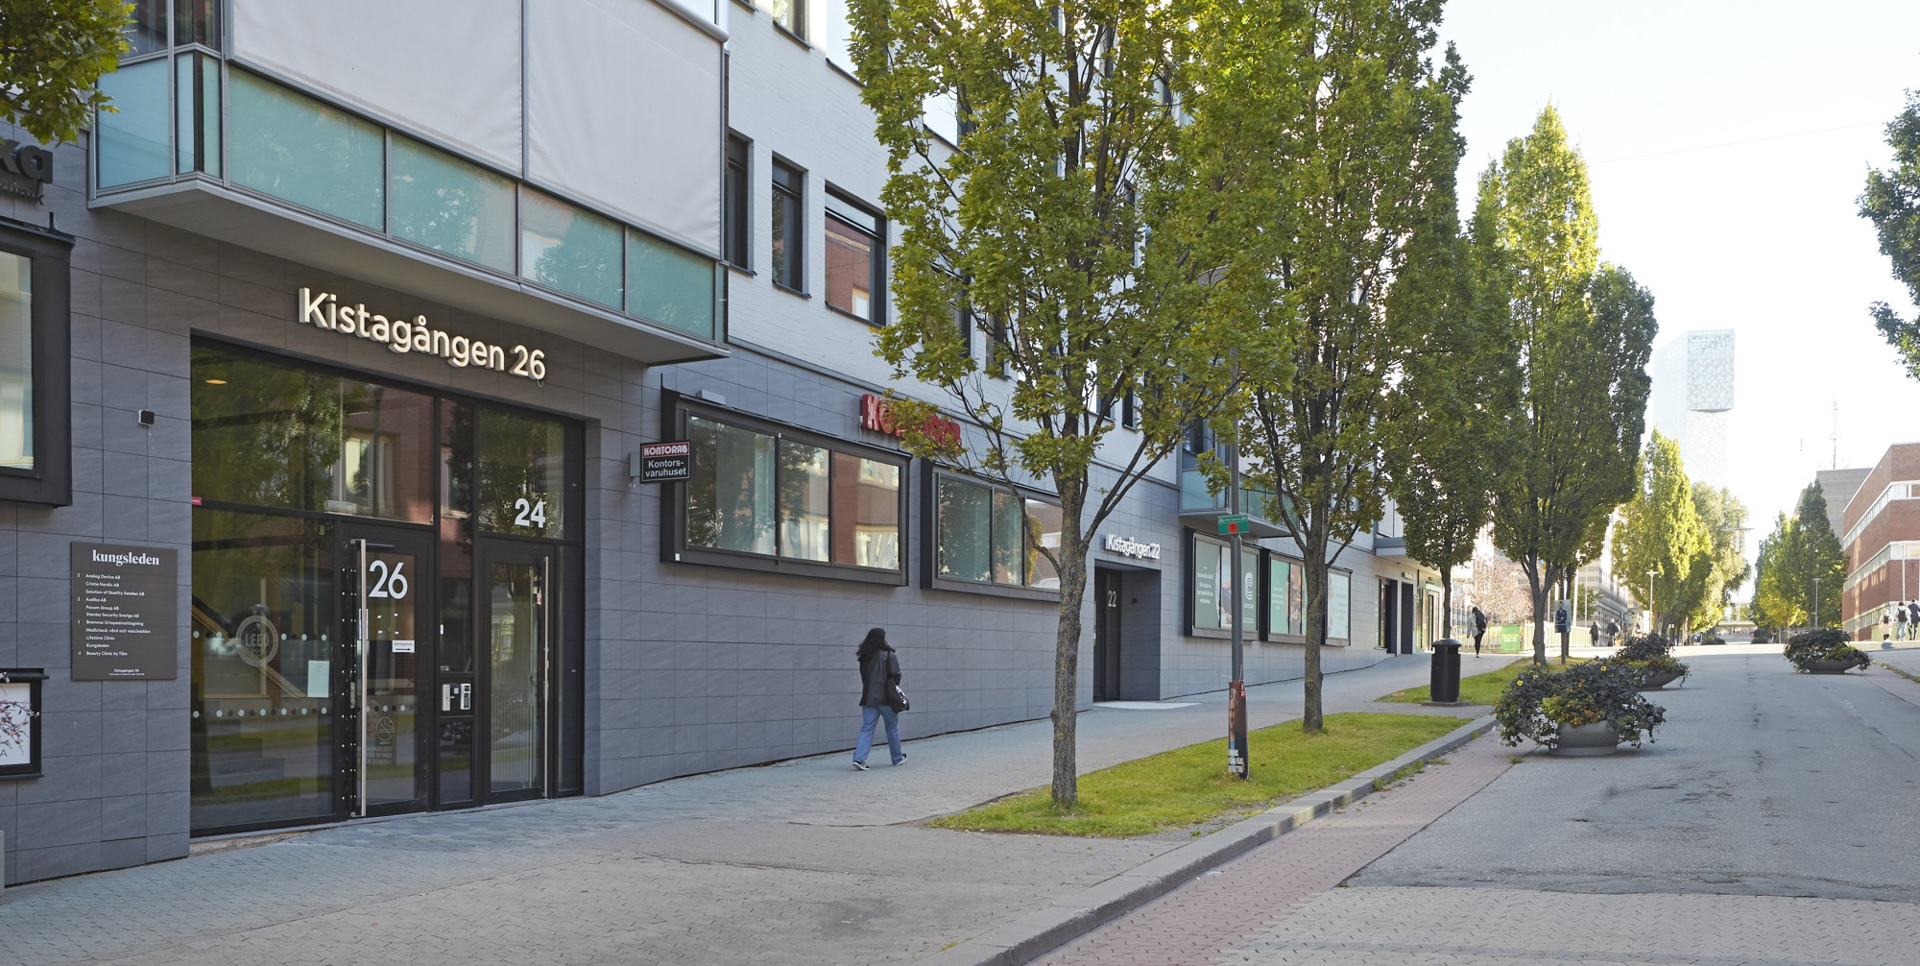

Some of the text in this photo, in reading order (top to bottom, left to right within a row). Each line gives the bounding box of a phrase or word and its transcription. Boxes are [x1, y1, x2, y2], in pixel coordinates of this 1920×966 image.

[299, 287, 546, 380] Kistagången 26
[644, 445, 688, 456] KONTORAB
[645, 467, 686, 477] varuhuset
[648, 460, 684, 468] Kontors-
[514, 497, 546, 528] 24
[1105, 533, 1160, 559] Kistagången 22
[92, 549, 160, 567] kungsleden
[368, 560, 408, 599] 26
[1107, 590, 1117, 608] 22
